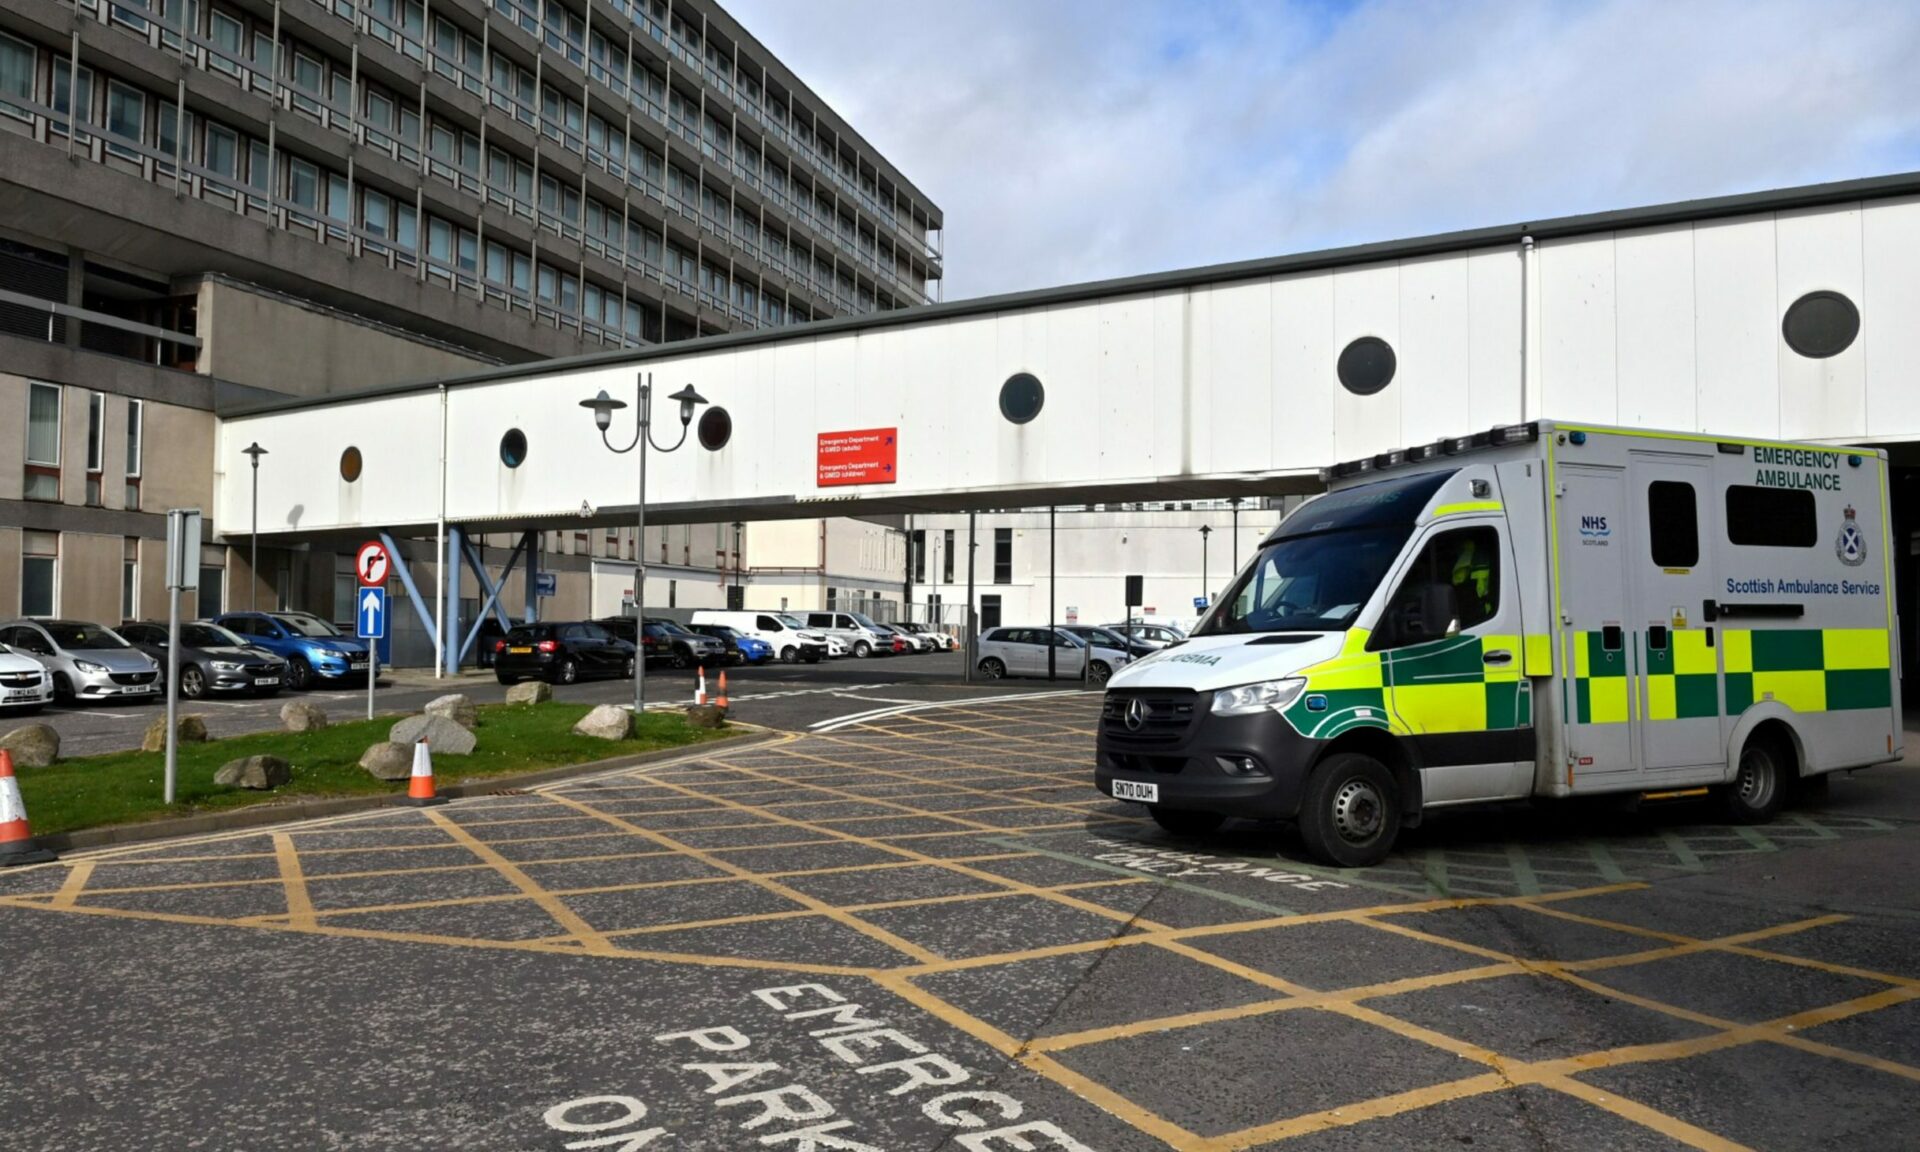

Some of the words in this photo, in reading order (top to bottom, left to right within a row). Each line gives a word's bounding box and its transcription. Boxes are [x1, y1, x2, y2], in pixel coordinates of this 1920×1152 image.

[1754, 448, 1839, 469] EMERGENCY
[1755, 469, 1841, 491] AMBULANCE
[1582, 516, 1607, 530] NHS
[1582, 539, 1609, 547] SCOTLAND
[1727, 578, 1774, 594] Scottish
[1778, 578, 1838, 595] Ambulance
[1842, 580, 1880, 595] Service
[1115, 781, 1134, 796] SN70
[1136, 784, 1153, 799] OUH
[1093, 852, 1221, 877] ONLY
